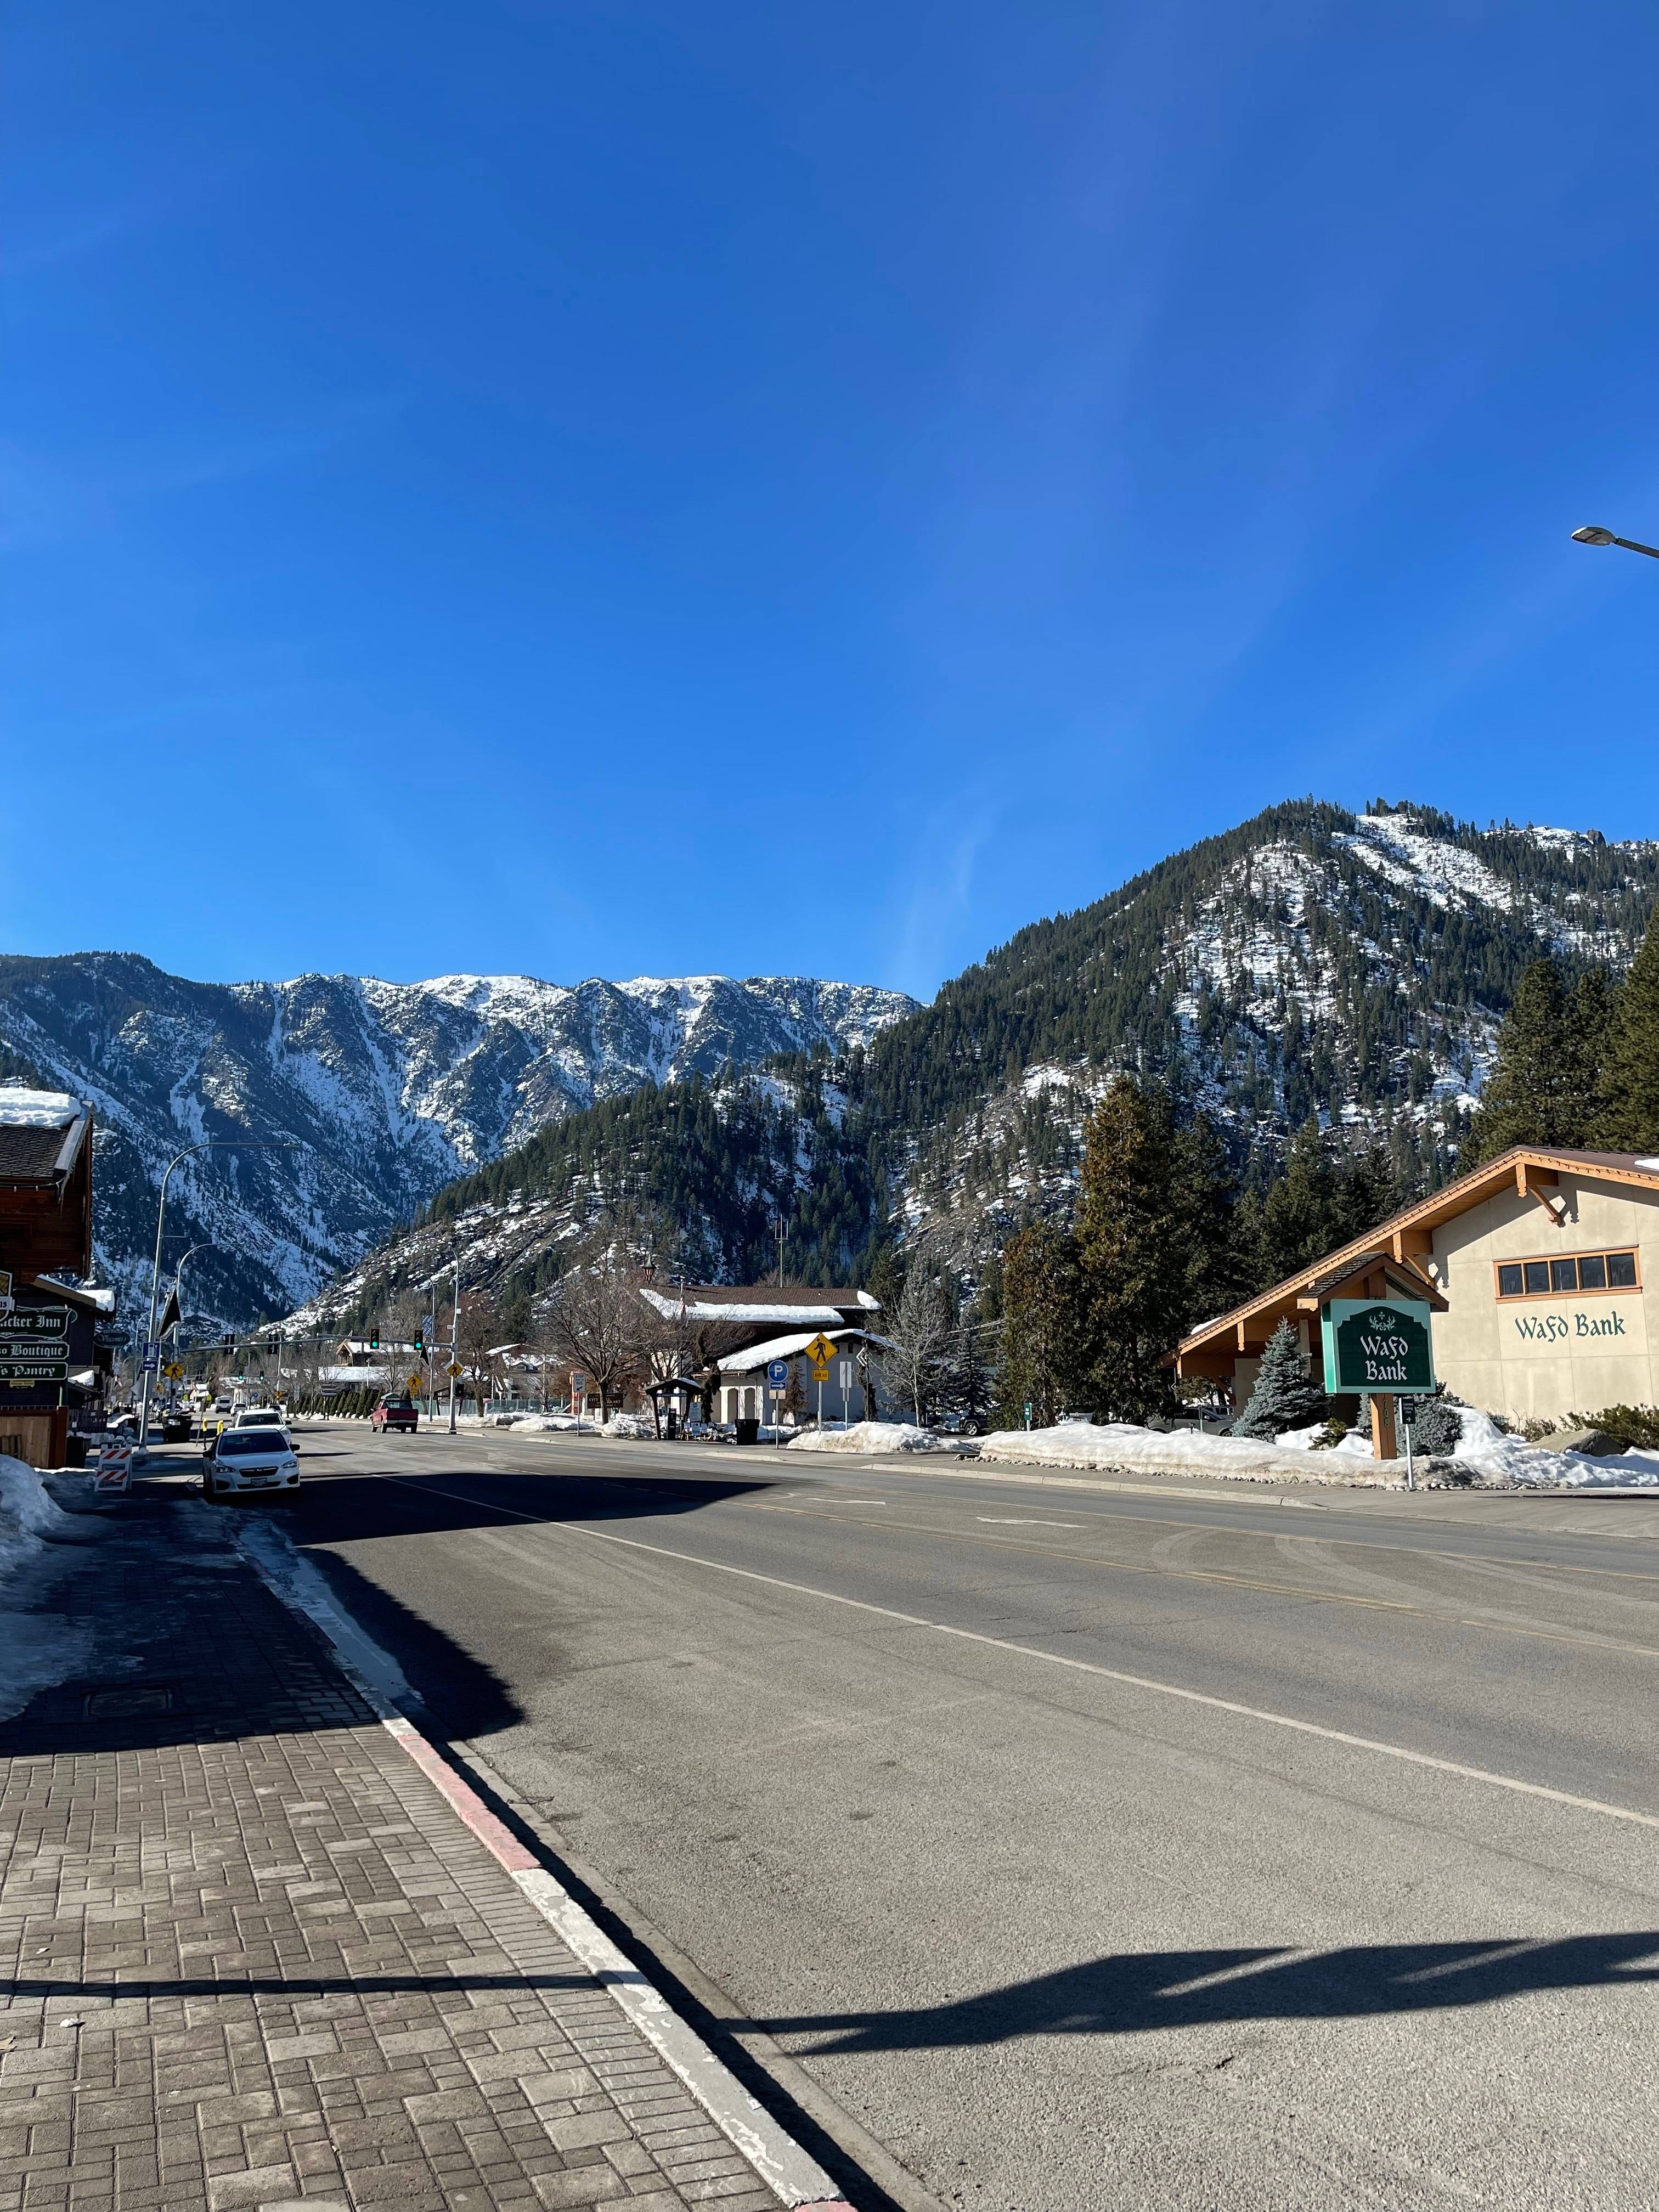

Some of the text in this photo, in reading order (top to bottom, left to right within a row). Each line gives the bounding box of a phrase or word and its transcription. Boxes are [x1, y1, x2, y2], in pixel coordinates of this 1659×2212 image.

[35, 1315, 60, 1327] Inn
[1575, 1310, 1626, 1337] Bank
[10, 1345, 63, 1357] Boutique
[12, 1365, 55, 1376] Pantry
[774, 1365, 783, 1377] P
[1365, 1359, 1408, 1381] Bank
